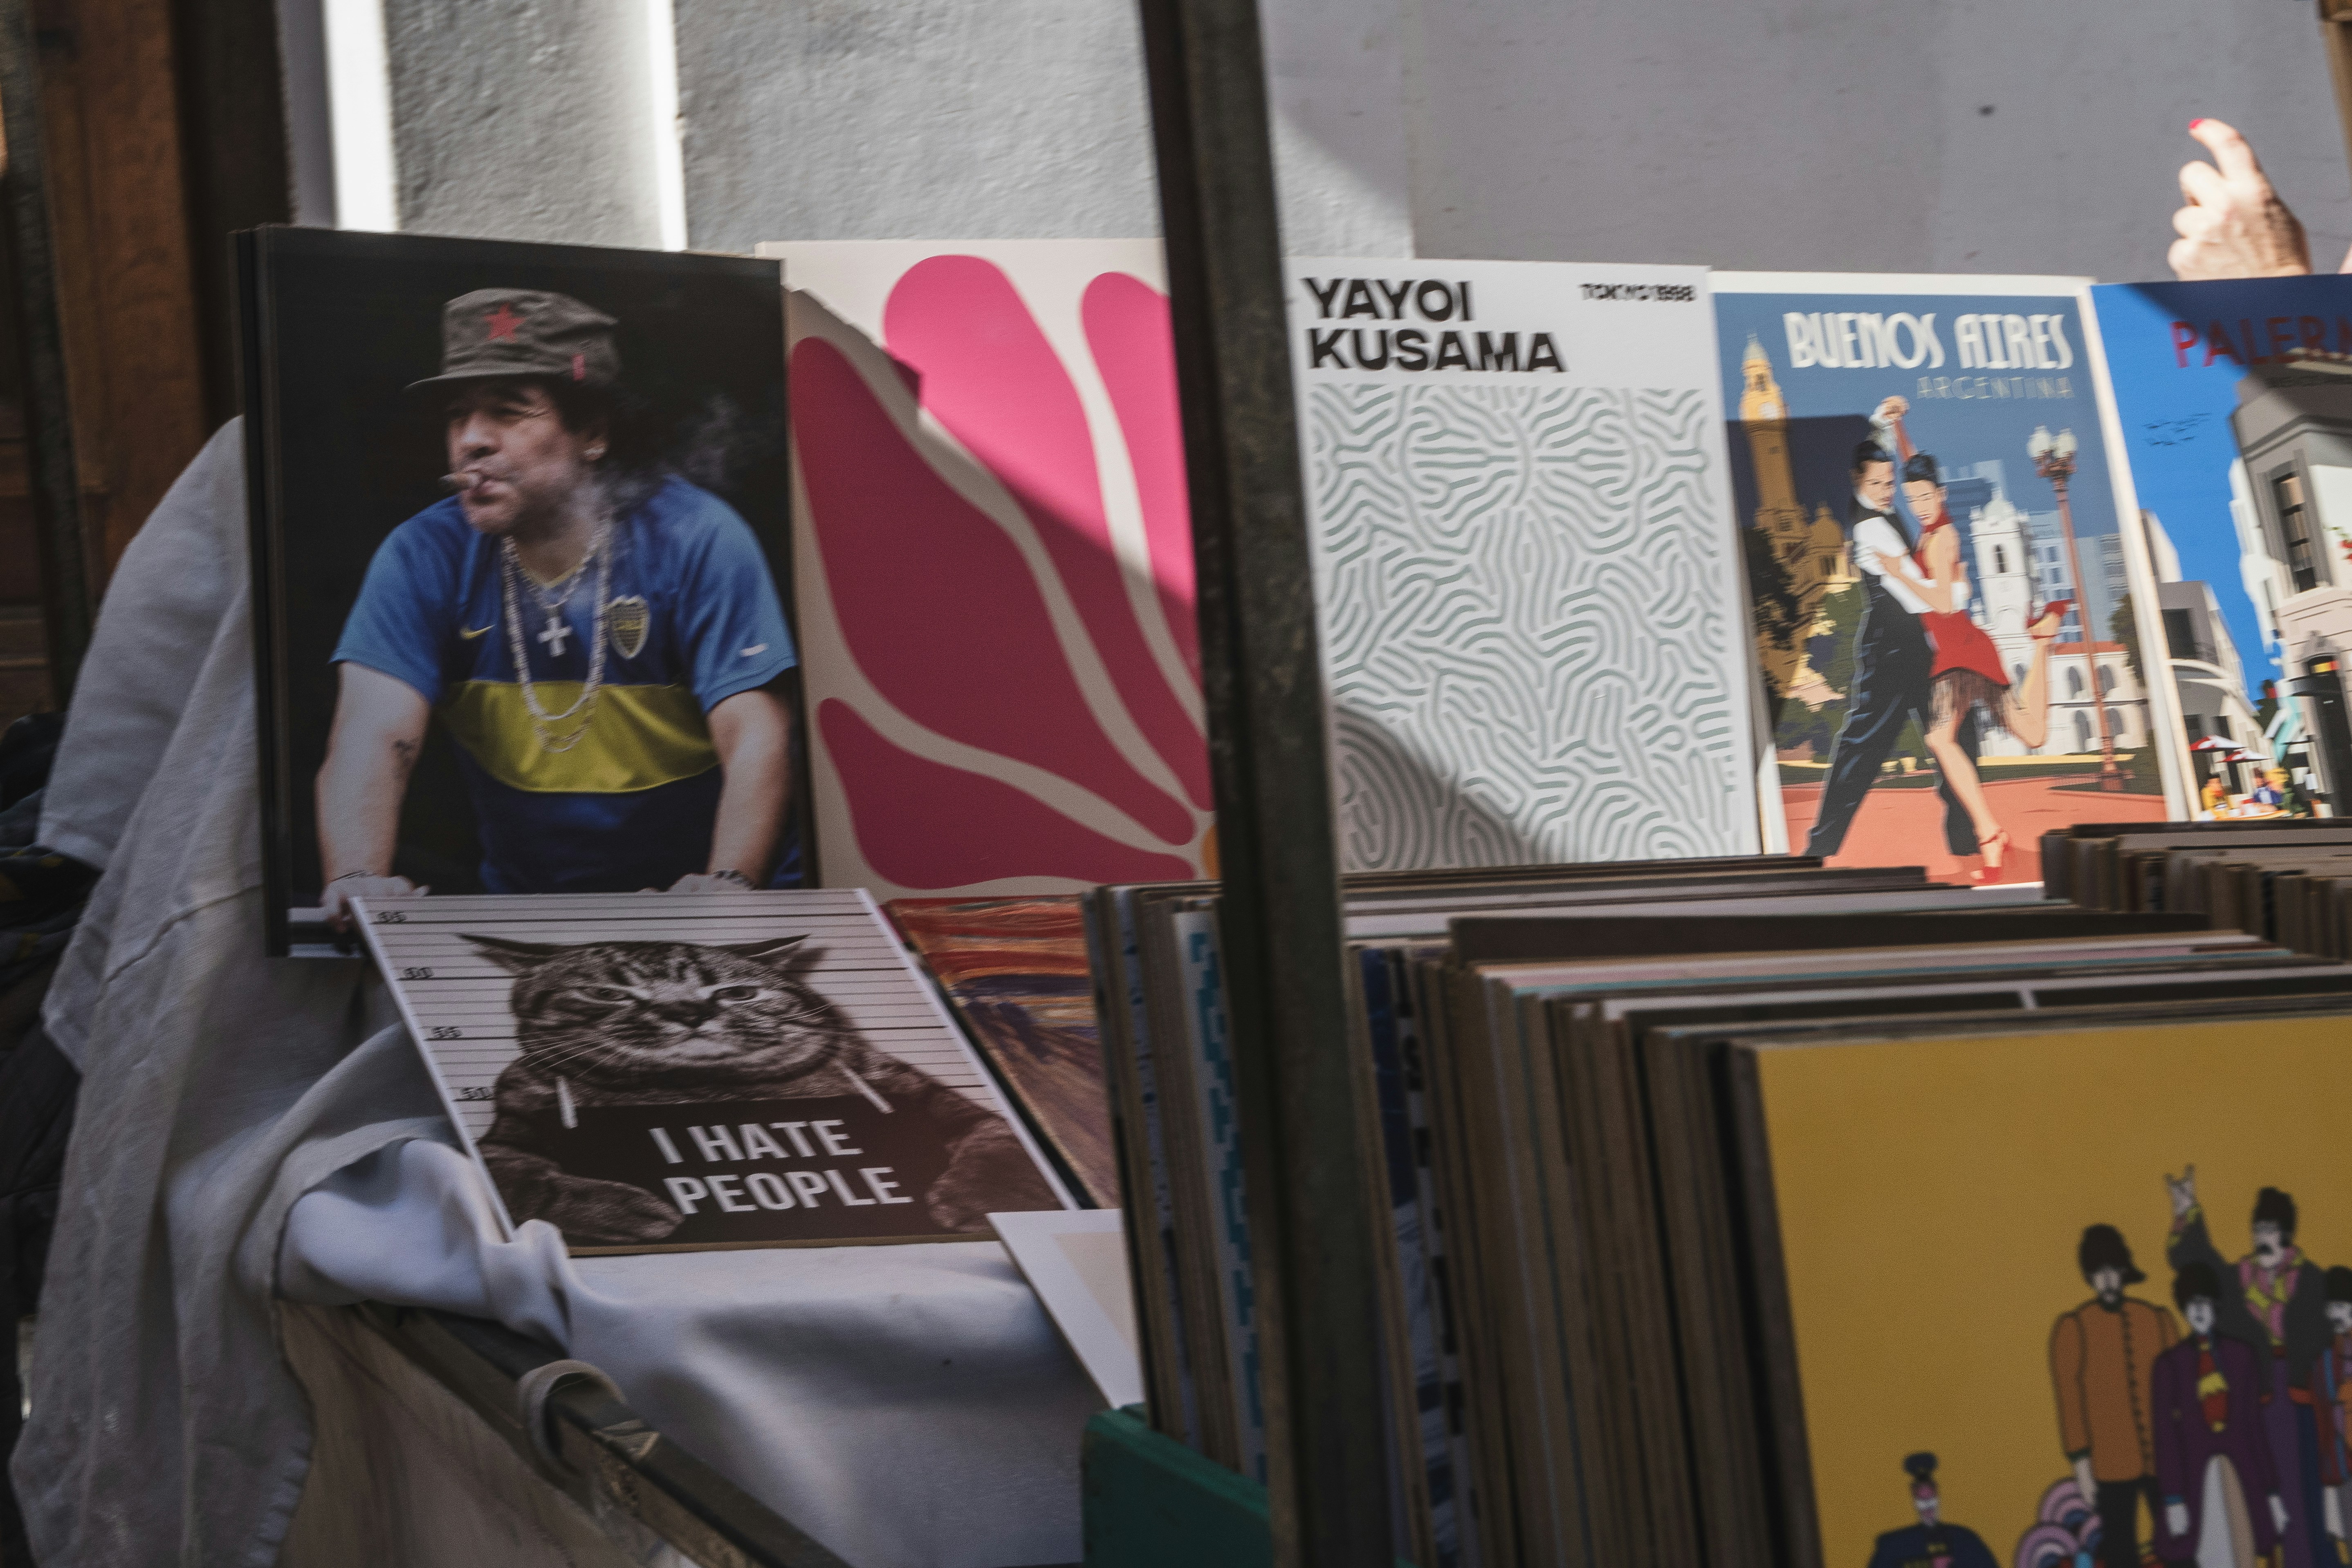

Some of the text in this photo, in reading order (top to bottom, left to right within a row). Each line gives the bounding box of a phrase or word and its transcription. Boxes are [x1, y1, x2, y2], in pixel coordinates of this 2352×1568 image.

[1302, 278, 1474, 321] YAYOI
[1579, 283, 1650, 301] TOKYO
[1309, 328, 1569, 372] KUSAMA
[1783, 312, 2073, 369] BUENOS AIRES
[1917, 376, 2075, 399] ARGENTINA
[649, 1119, 864, 1164] I HATE
[662, 1166, 914, 1214] PEOPLE
